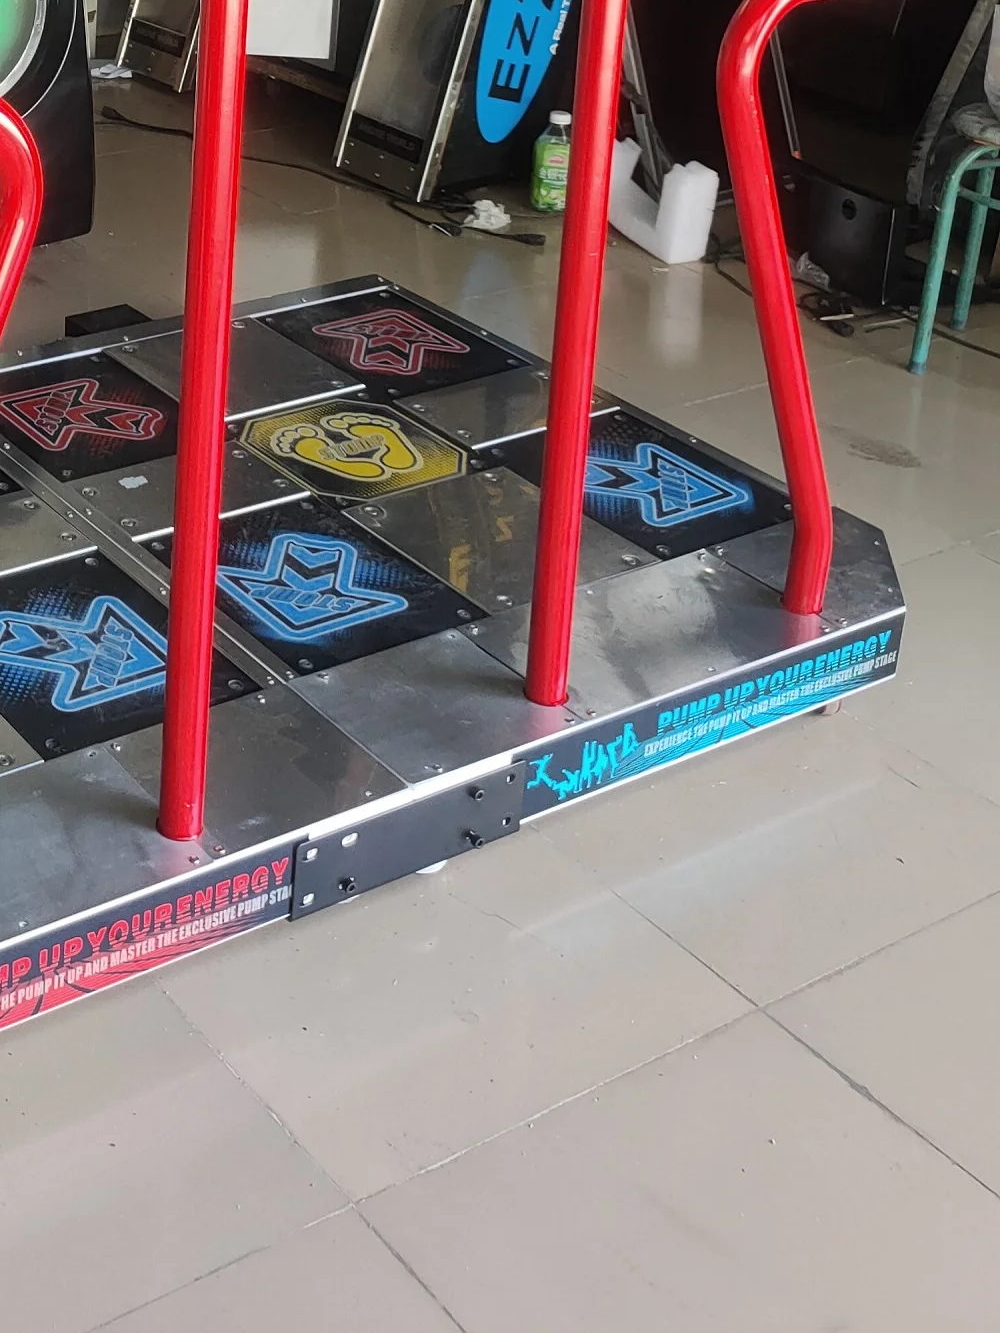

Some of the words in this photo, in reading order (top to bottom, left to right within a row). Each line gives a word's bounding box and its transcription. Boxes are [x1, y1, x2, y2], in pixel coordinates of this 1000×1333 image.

[552, 10, 568, 42] Real
[549, 43, 559, 55] A
[319, 434, 385, 460] STOMP
[247, 585, 358, 612] STOMP
[644, 730, 694, 757] EXPERIENCE
[693, 724, 709, 739] THE
[708, 713, 732, 733] PUMP
[770, 690, 799, 706] MASTER
[853, 659, 875, 676] PUMP
[874, 650, 897, 669] STAGE
[658, 693, 721, 736] PUMP
[17, 979, 52, 1004] PUMP
[53, 973, 65, 990] IT
[66, 966, 83, 987] UP
[83, 956, 109, 979] AND
[109, 938, 158, 968] MASTER
[157, 930, 178, 949] THE
[178, 905, 236, 939] EXCLUSIVE
[237, 894, 269, 917] PUMP
